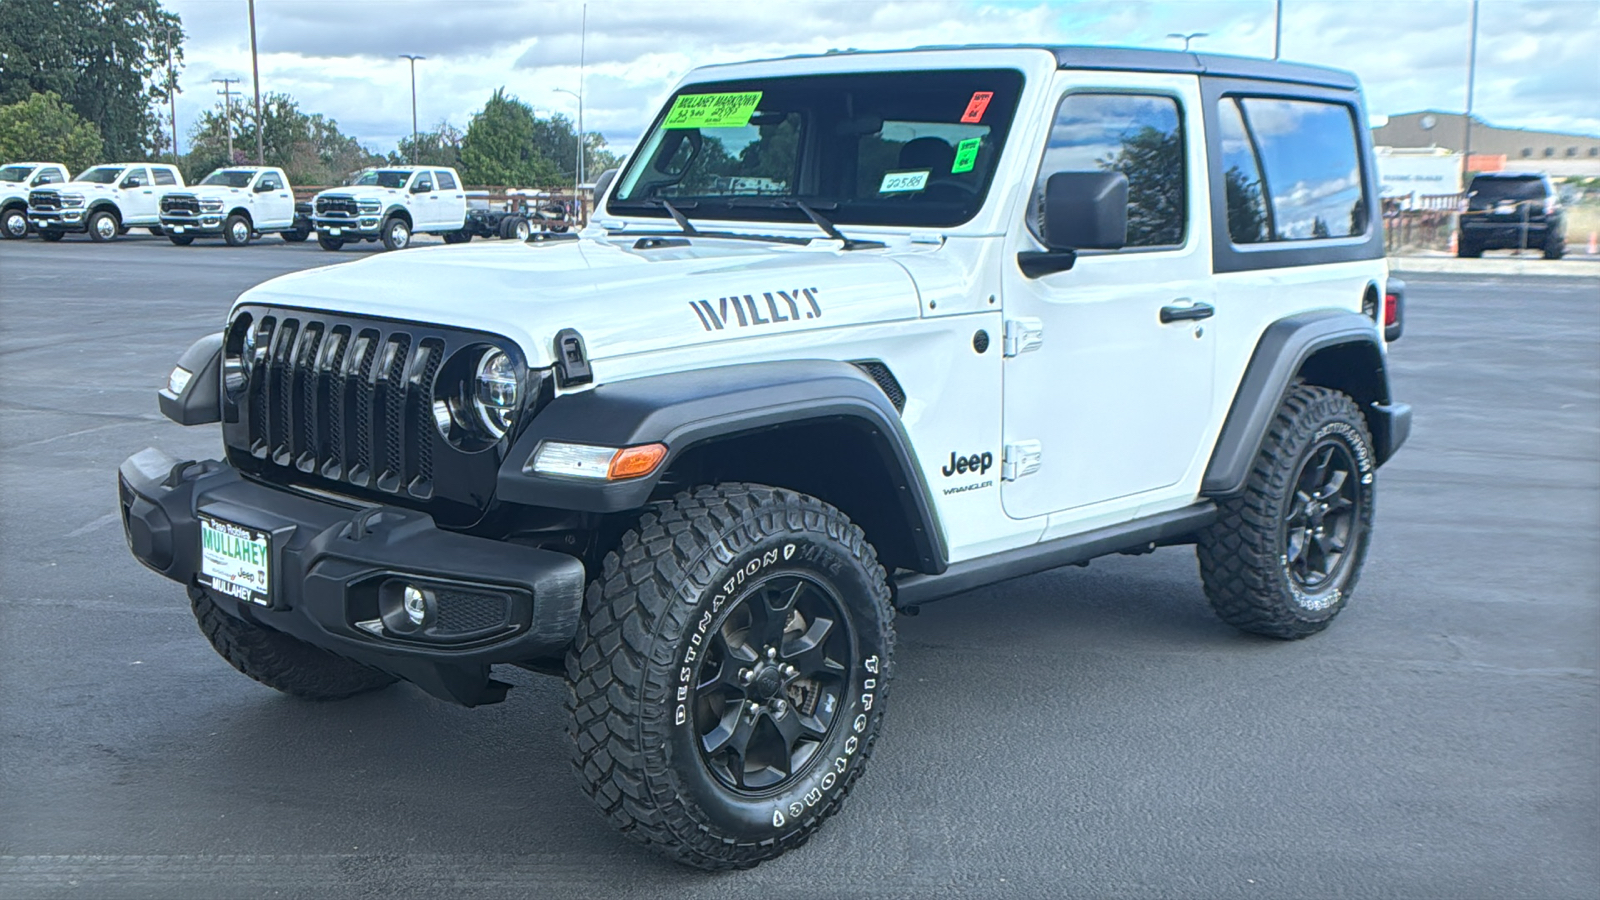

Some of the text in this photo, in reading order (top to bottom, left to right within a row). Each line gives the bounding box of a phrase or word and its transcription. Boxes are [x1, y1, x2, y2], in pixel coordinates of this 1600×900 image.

[688, 287, 822, 331] WILLYS
[942, 451, 993, 477] Jeep
[943, 480, 993, 496] WRANGLER
[211, 519, 227, 533] Paso
[226, 523, 251, 540] Robles
[203, 527, 267, 567] MULLAHEY
[238, 567, 255, 583] Jeep
[212, 577, 252, 602] MULLAHEY
[675, 548, 779, 725] DESTINATION
